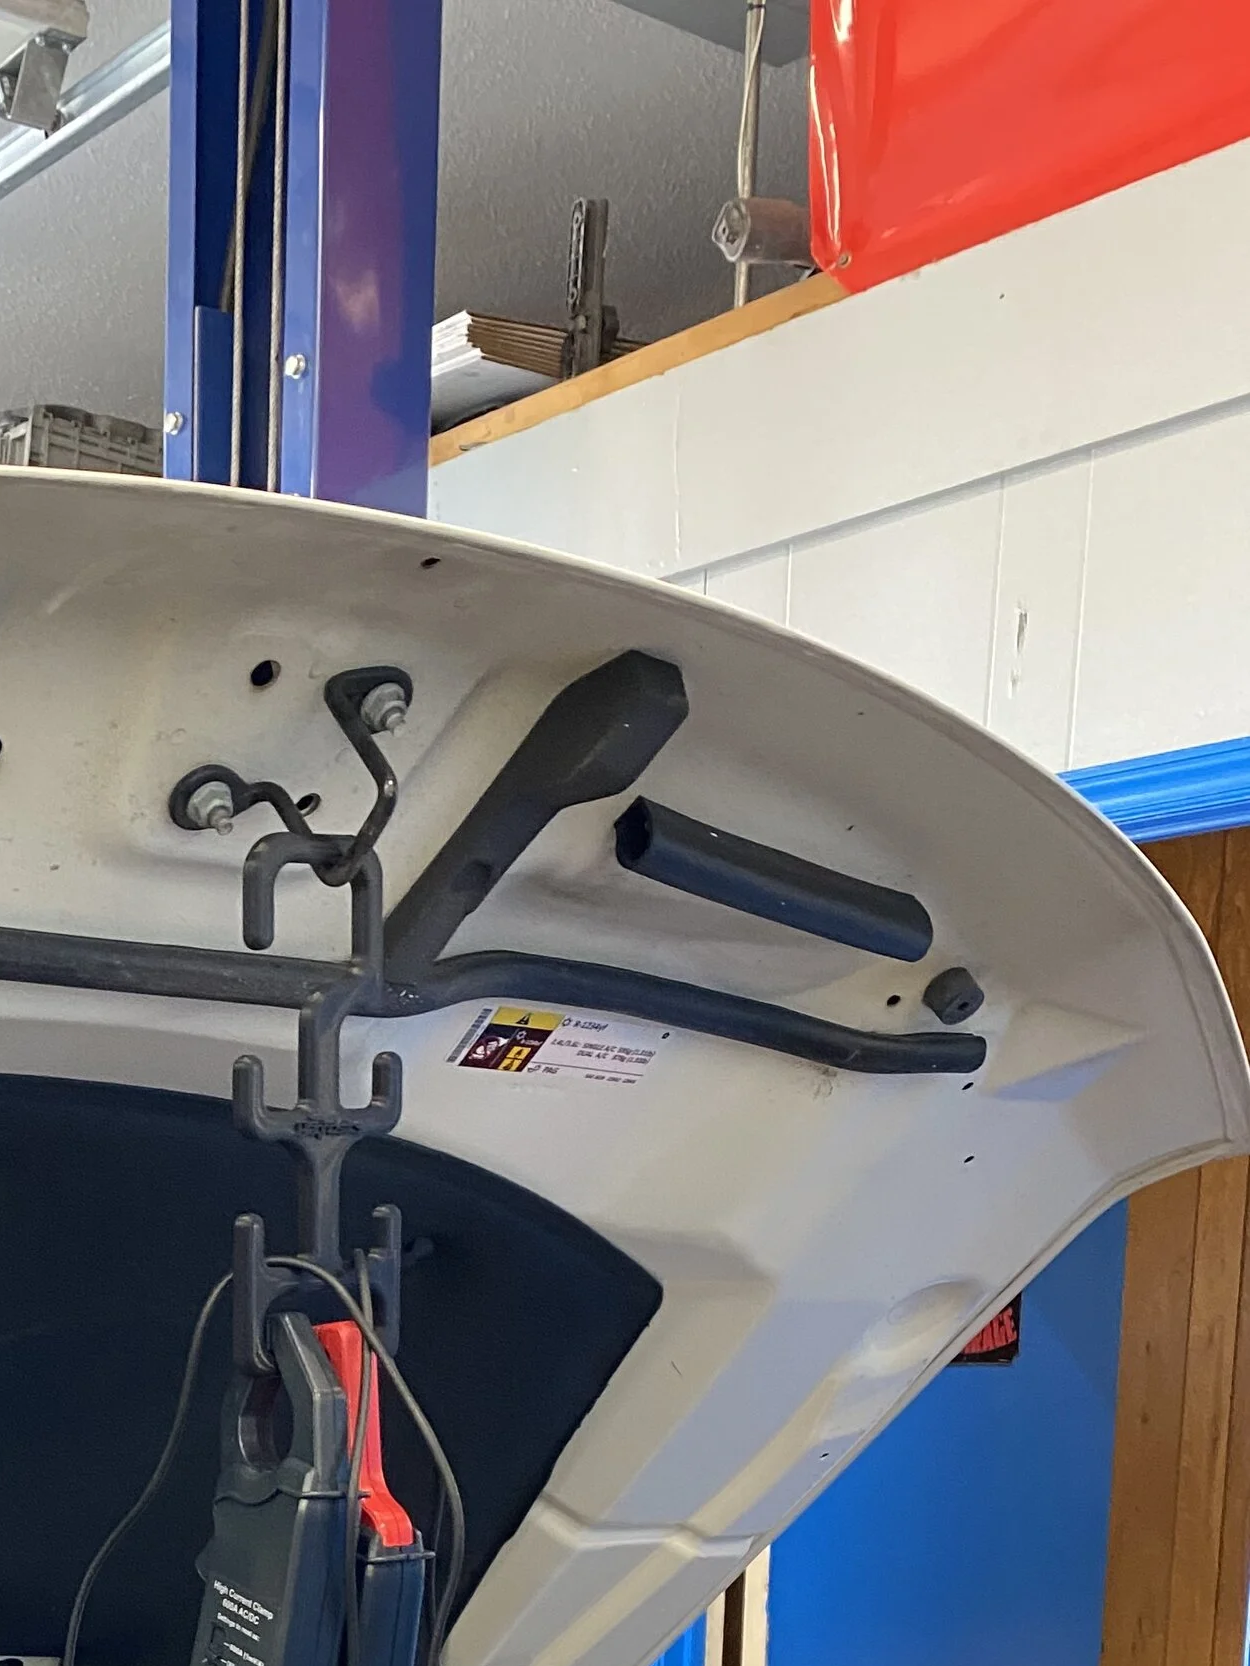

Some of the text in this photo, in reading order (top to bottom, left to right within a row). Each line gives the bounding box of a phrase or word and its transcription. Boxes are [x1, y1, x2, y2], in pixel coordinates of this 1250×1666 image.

[213, 1579, 274, 1621] High Current Clamp
[238, 1607, 260, 1626] AC/DC
